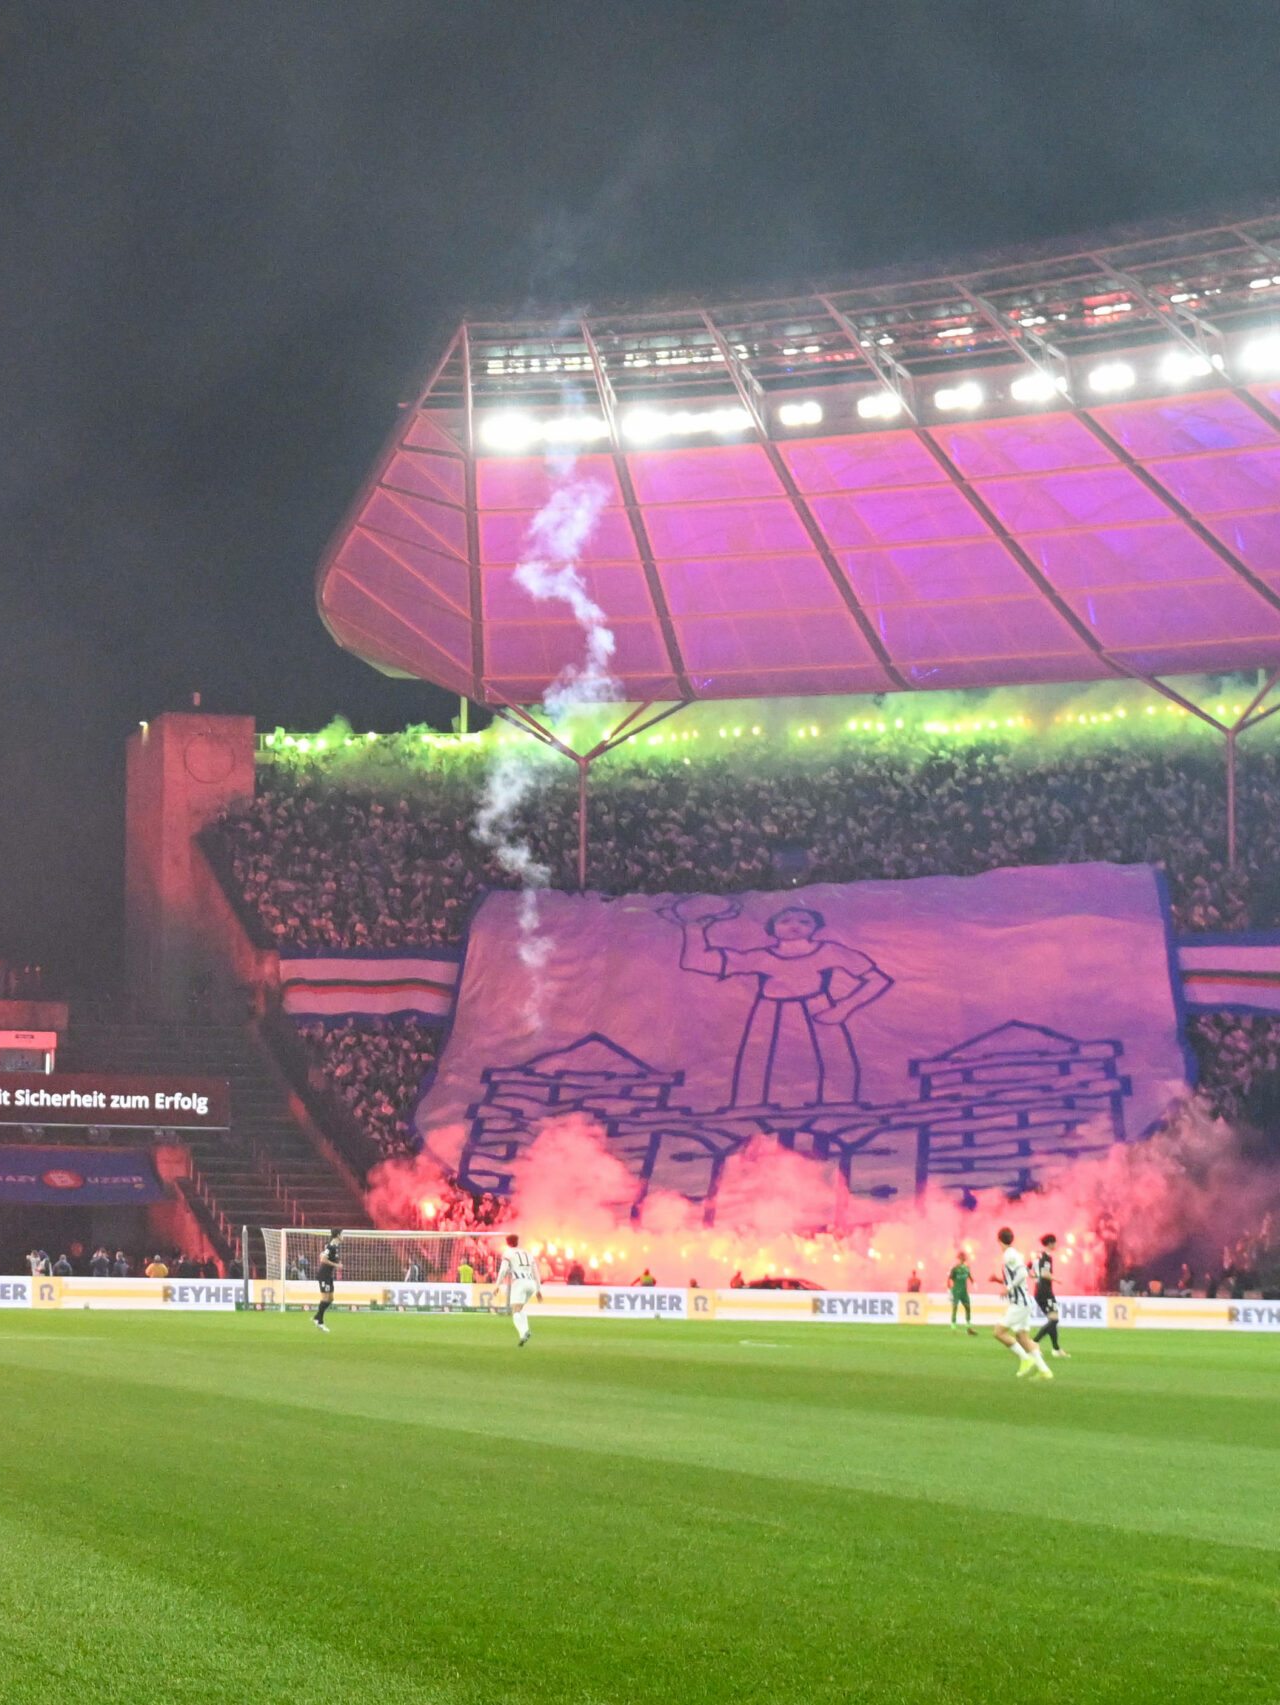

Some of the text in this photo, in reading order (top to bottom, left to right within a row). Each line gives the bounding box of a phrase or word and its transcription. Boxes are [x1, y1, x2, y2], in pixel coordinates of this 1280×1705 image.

[14, 1089, 106, 1108] Sicherheit
[110, 1095, 150, 1109] zum
[154, 1093, 209, 1115] Erfolg
[382, 1289, 468, 1307] REYHER
[598, 1293, 683, 1312] REYHER
[811, 1298, 894, 1316] REYHER
